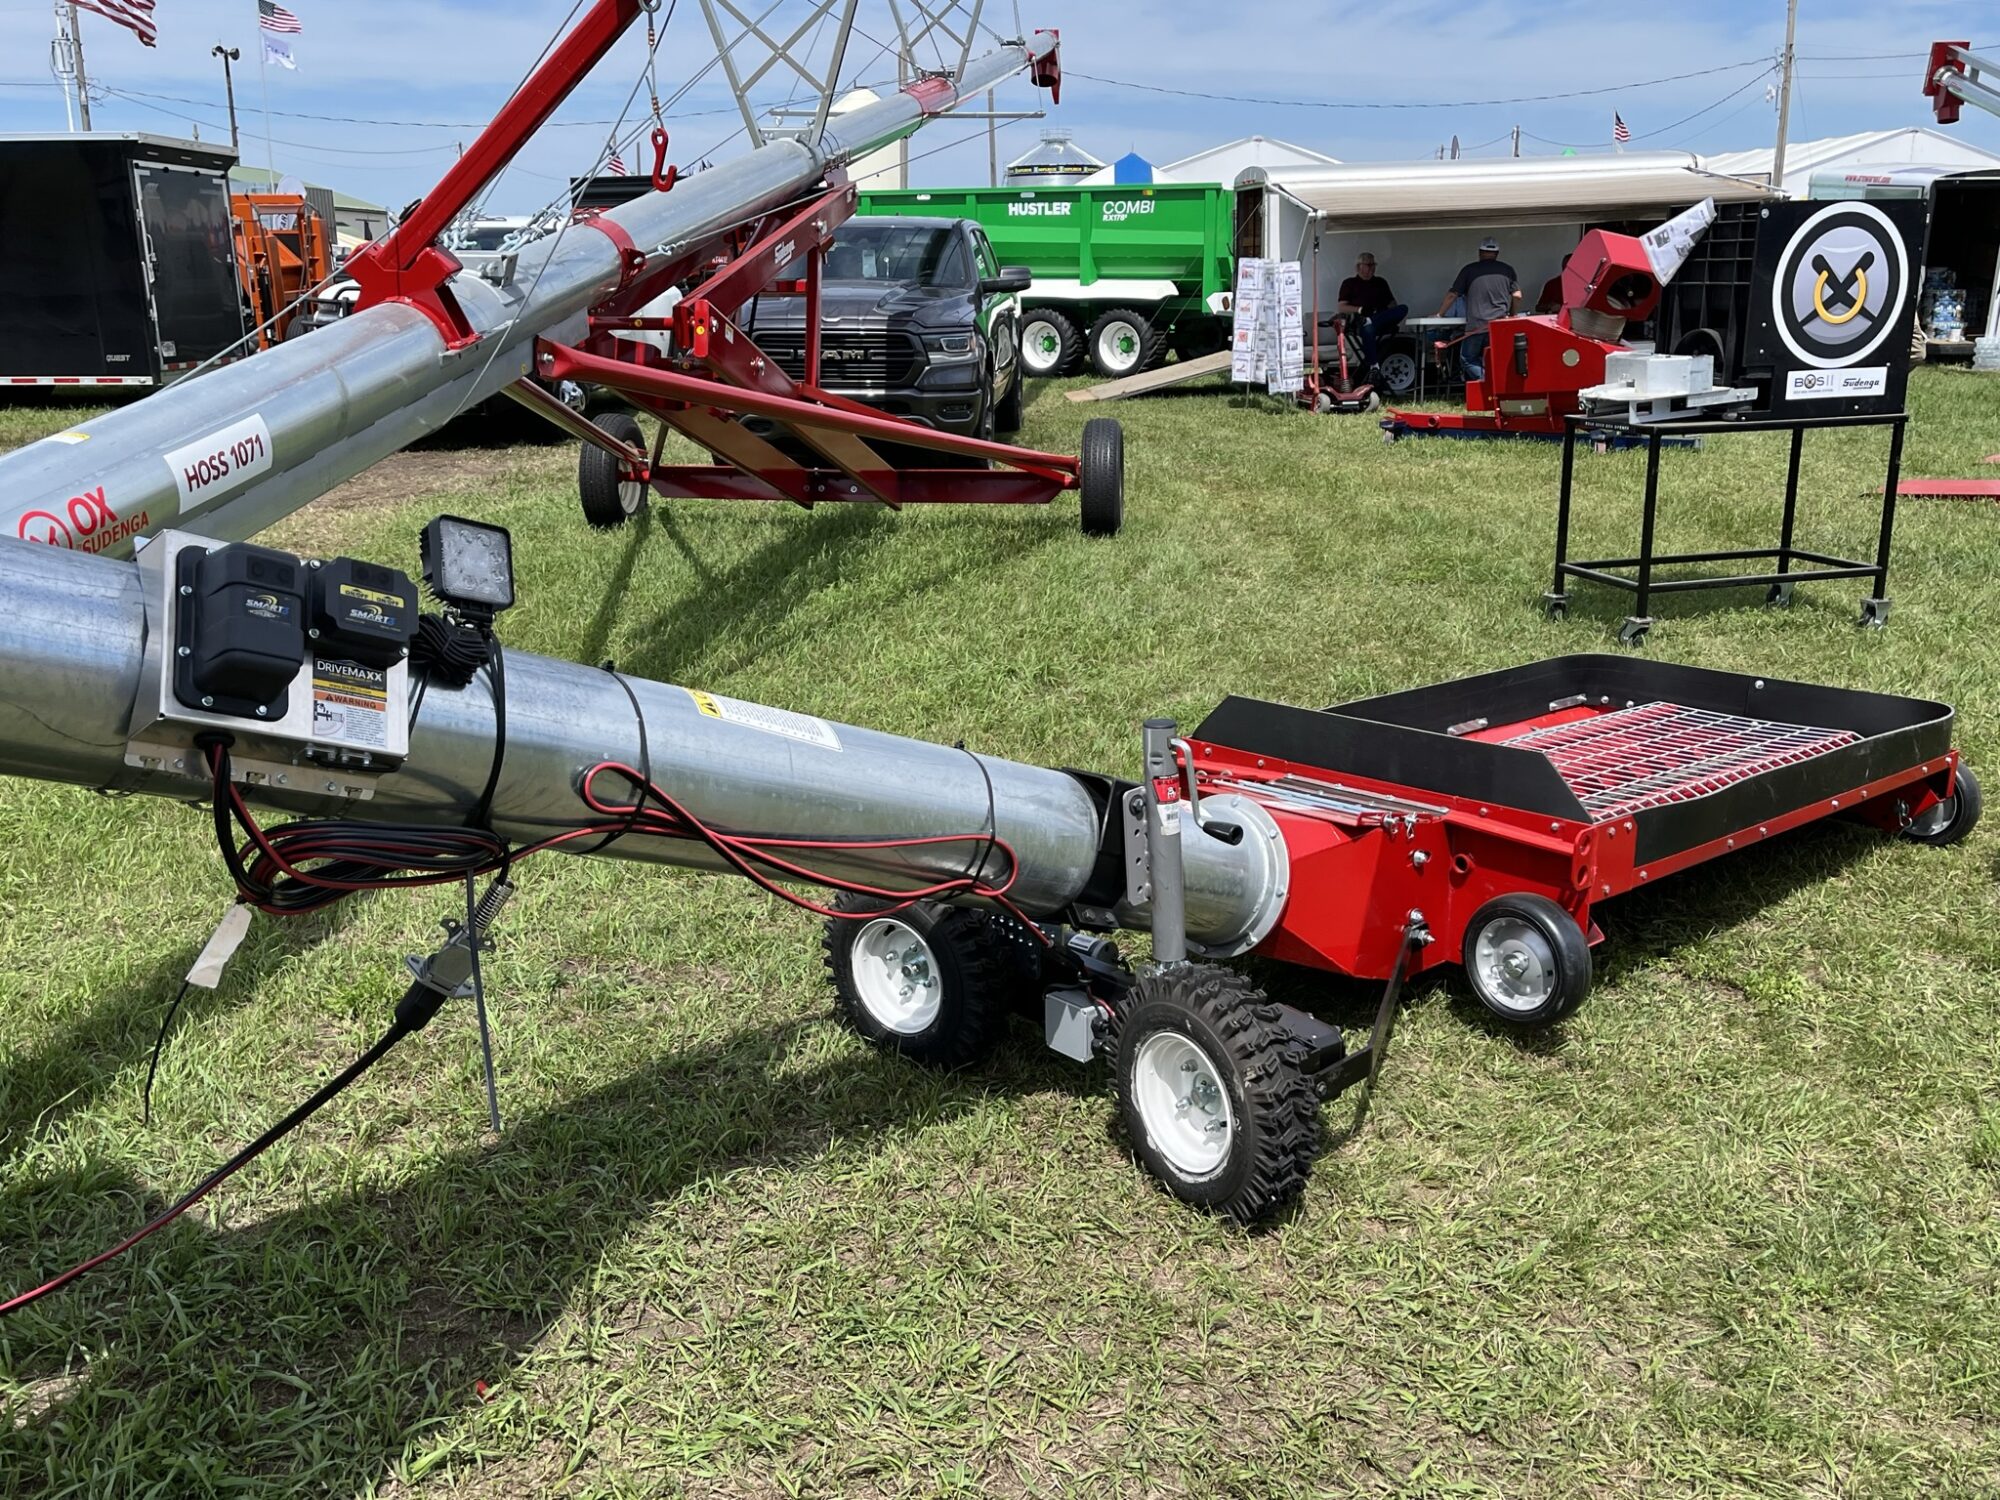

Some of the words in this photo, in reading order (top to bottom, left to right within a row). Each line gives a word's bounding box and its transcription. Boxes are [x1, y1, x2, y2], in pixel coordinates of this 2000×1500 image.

[1008, 202, 1071, 216] HUSTLER
[1102, 200, 1155, 214] COMBI
[1842, 378, 1880, 389] Sudenga
[184, 451, 229, 492] HOSS
[230, 433, 264, 470] 1071
[67, 486, 119, 536] OX
[82, 511, 150, 554] SUDENGA
[317, 660, 383, 682] DRIVEMAXX
[334, 694, 377, 709] WARNING
